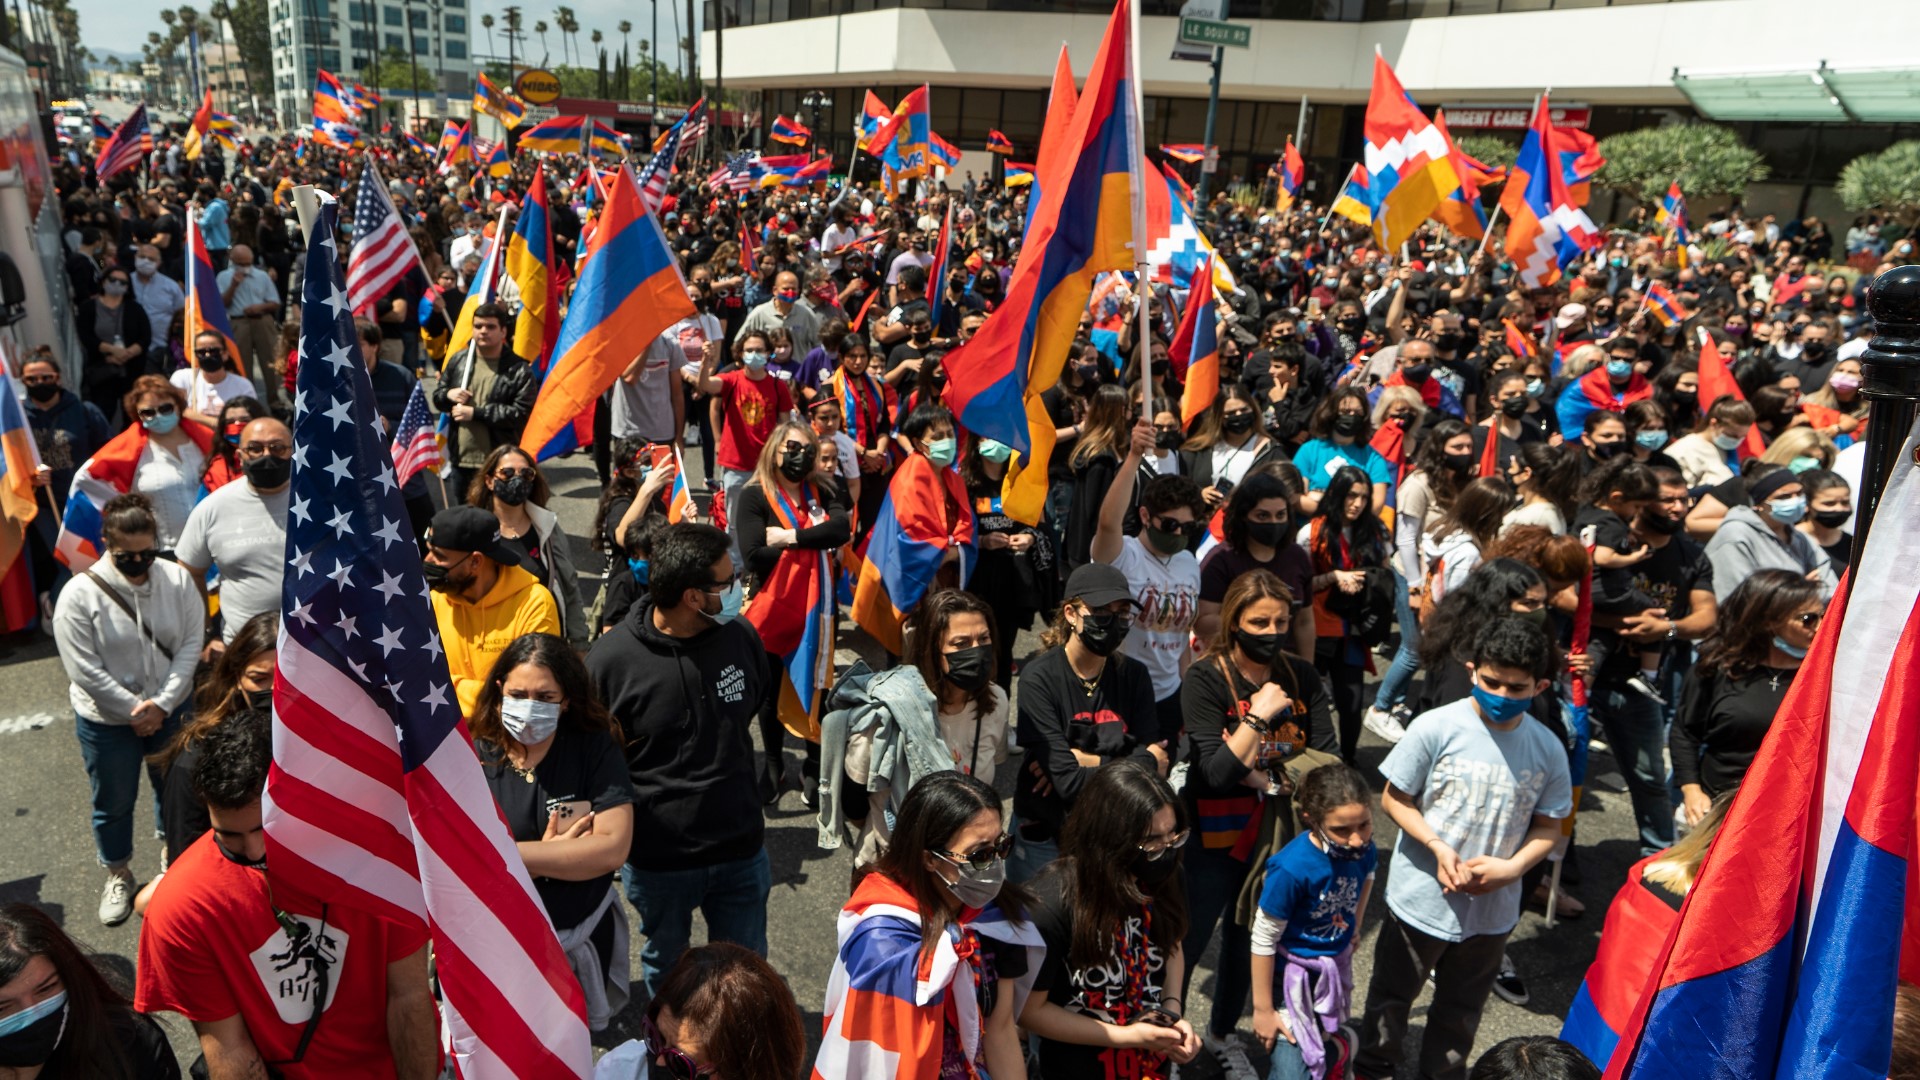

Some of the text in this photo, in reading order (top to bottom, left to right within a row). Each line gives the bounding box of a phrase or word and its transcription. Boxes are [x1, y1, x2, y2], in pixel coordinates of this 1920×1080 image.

[1187, 23, 1247, 42] LE DOUX RD
[522, 81, 560, 94] MIDAS
[1446, 111, 1527, 127] URGENT CARE
[720, 664, 736, 678] ANTI
[716, 669, 745, 690] ERDOGAN
[724, 692, 743, 703] CLUB
